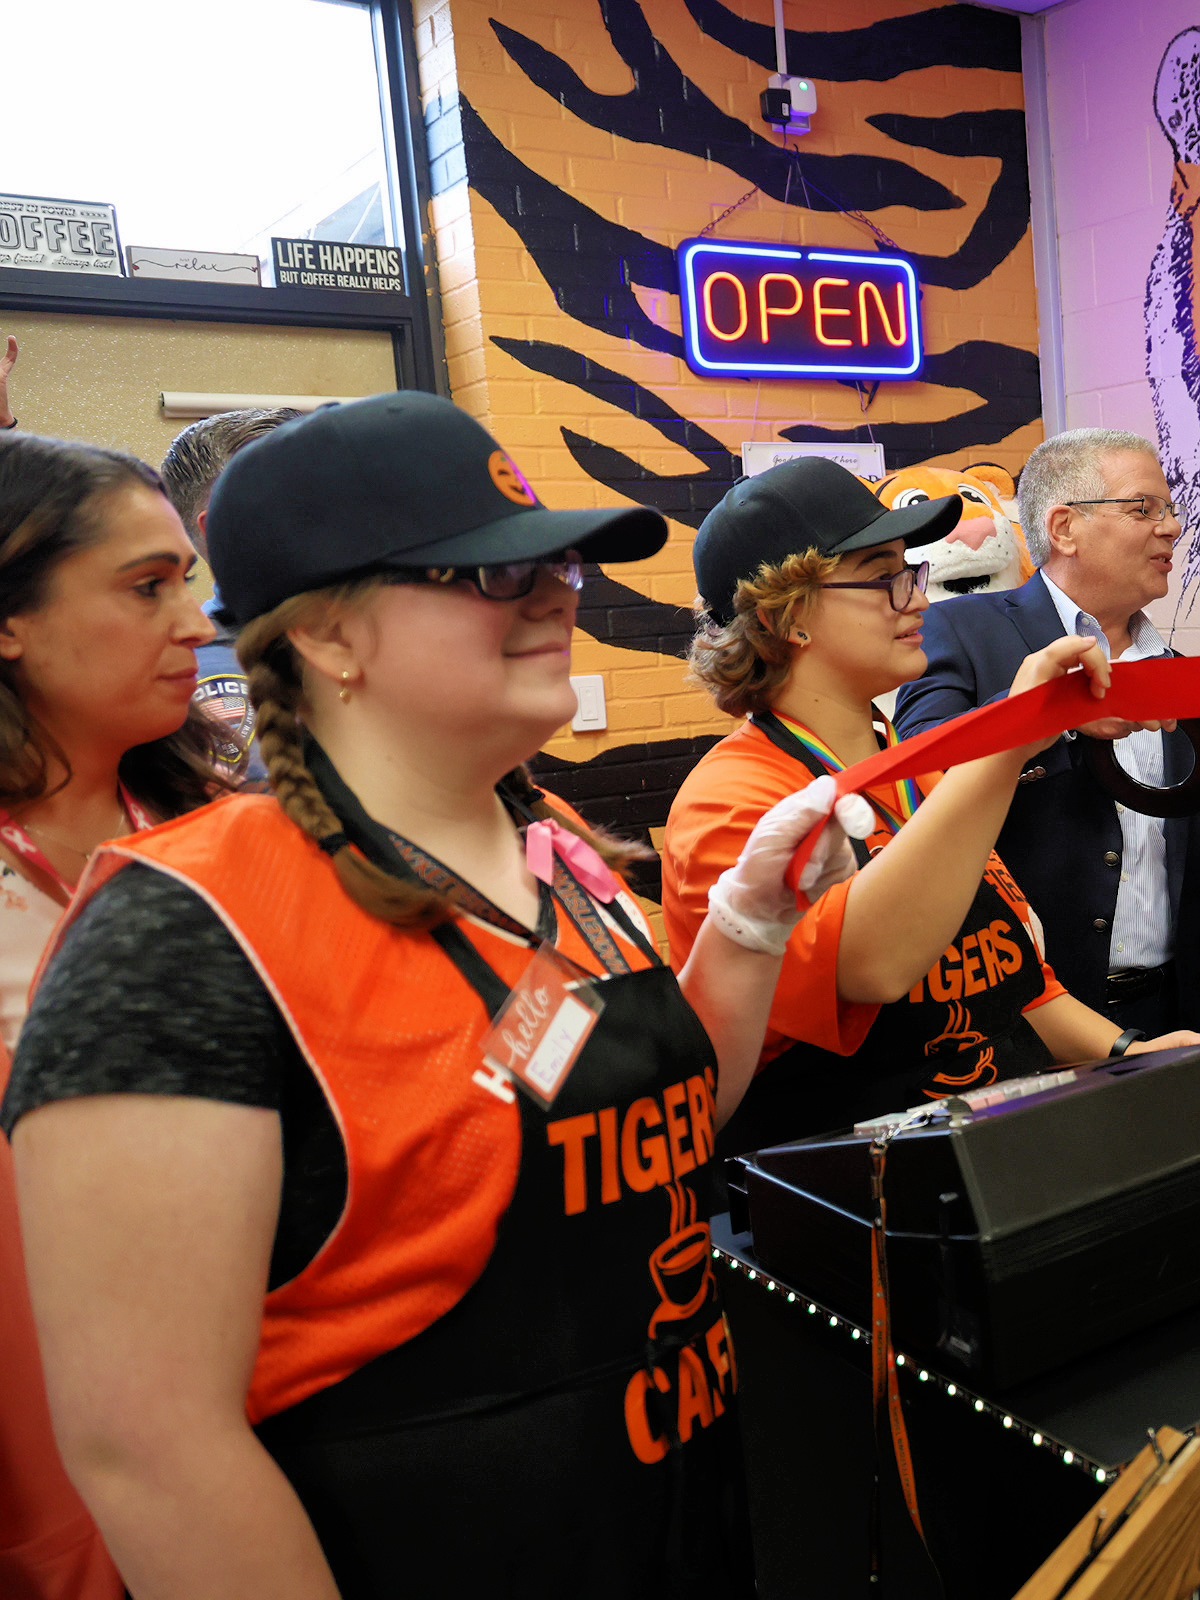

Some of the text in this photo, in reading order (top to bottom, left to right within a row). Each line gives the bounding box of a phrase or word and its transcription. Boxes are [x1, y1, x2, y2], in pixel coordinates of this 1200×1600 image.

[0, 212, 116, 258] OFFEE
[174, 257, 218, 272] relax
[276, 241, 400, 276] LIFE HAPPENS
[280, 270, 401, 291] BUT COFFEE REALLY HELPS
[703, 271, 908, 348] OPEN
[192, 681, 249, 702] OLICE
[502, 985, 549, 1067] hello
